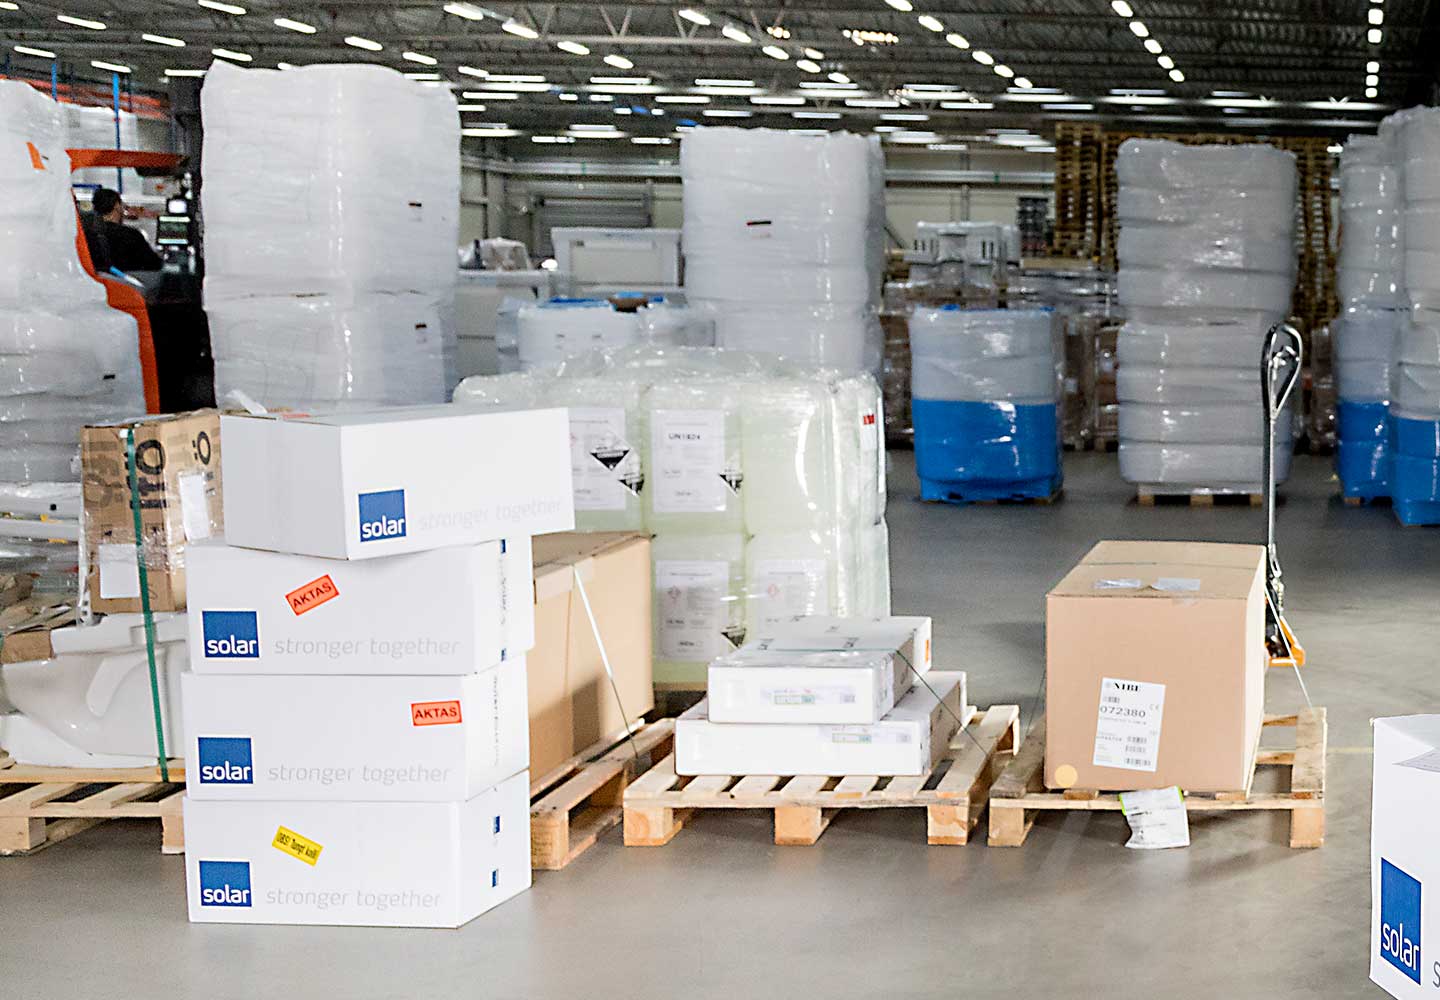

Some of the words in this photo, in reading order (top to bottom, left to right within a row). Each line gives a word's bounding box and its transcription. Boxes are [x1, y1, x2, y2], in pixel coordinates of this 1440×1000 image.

[361, 515, 406, 538] solar
[418, 508, 489, 530] stronger
[496, 497, 562, 523] together
[292, 582, 332, 608] AKTAS
[207, 635, 257, 655] solar
[274, 638, 360, 659] stronger
[370, 638, 460, 659] together
[415, 707, 458, 719] AKTAS
[1099, 705, 1146, 718] 072380
[202, 761, 252, 781] solar
[268, 764, 354, 785] stronger
[363, 764, 451, 785] together
[203, 884, 250, 904] solar
[266, 888, 348, 909] stronger
[357, 890, 441, 911] together
[1382, 922, 1419, 971] solar
